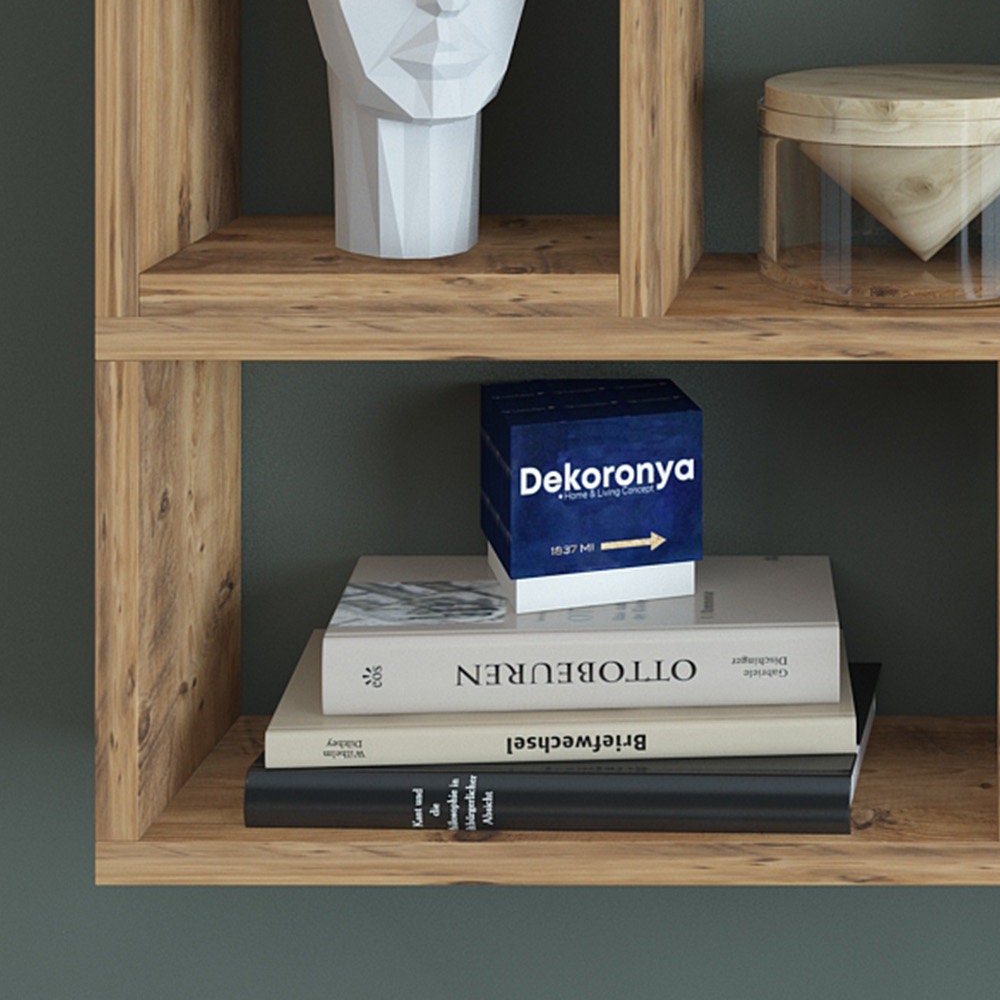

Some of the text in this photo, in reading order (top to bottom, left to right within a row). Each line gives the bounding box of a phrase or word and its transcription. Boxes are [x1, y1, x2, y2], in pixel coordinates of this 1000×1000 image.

[520, 458, 694, 496] Dekoronya
[564, 491, 588, 500] Home
[597, 487, 620, 497] Living
[622, 485, 654, 495] Concept
[732, 656, 788, 666] Dischinger
[456, 658, 697, 686] OTTOBEUREN
[743, 668, 788, 678] Gabriele
[506, 733, 647, 754] Briefwechsel
[323, 749, 365, 758] Wilhelm
[412, 788, 423, 828] Kant und
[429, 803, 440, 817] die
